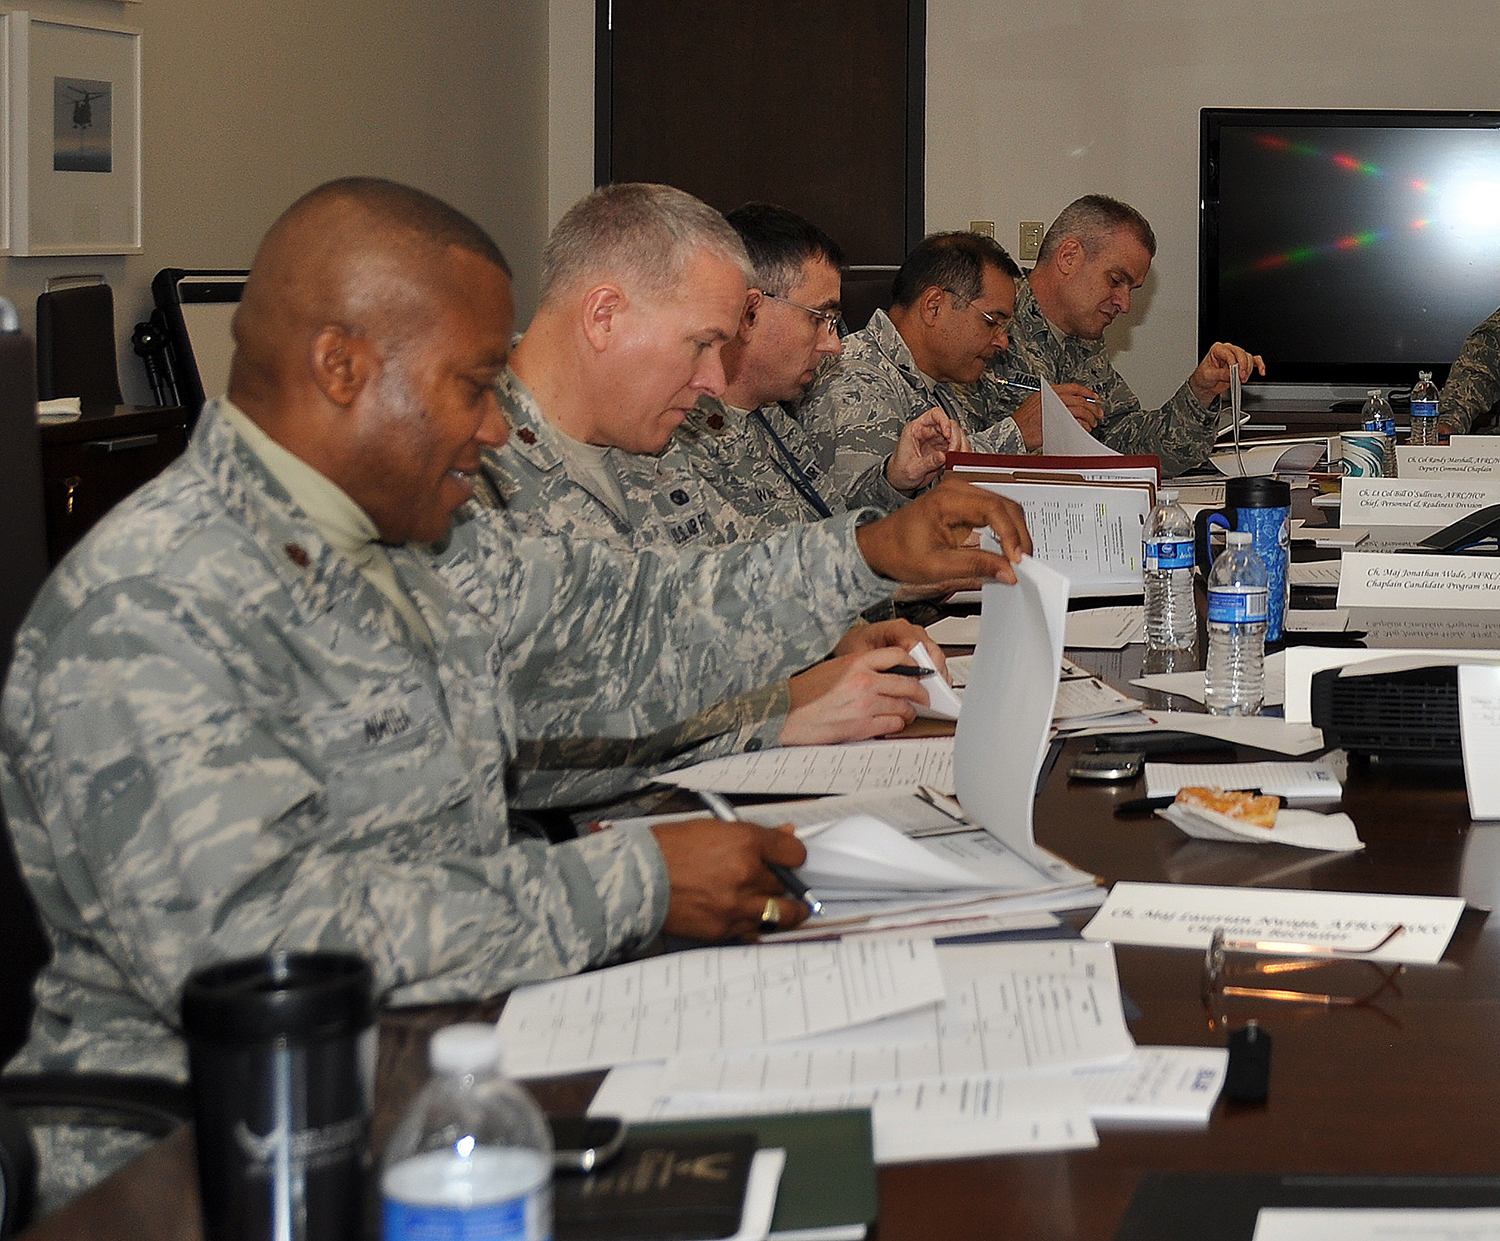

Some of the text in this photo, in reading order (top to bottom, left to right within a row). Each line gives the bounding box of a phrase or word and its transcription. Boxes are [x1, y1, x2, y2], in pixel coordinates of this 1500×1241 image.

[1440, 465, 1466, 473] Command
[1467, 465, 1492, 474] Chaplain
[1381, 489, 1393, 497] Col
[1394, 489, 1407, 498] Bill
[1360, 499, 1379, 508] Chief,
[1381, 499, 1412, 508] Personnel
[1422, 501, 1454, 509] Readiness
[1456, 501, 1482, 509] Division
[1383, 568, 1401, 578] Maj
[1402, 568, 1440, 578] Jonathan
[1442, 569, 1467, 579] Wade,
[1366, 579, 1402, 589] Chaplain
[1403, 580, 1445, 589] Candidate
[1446, 581, 1481, 592] Program
